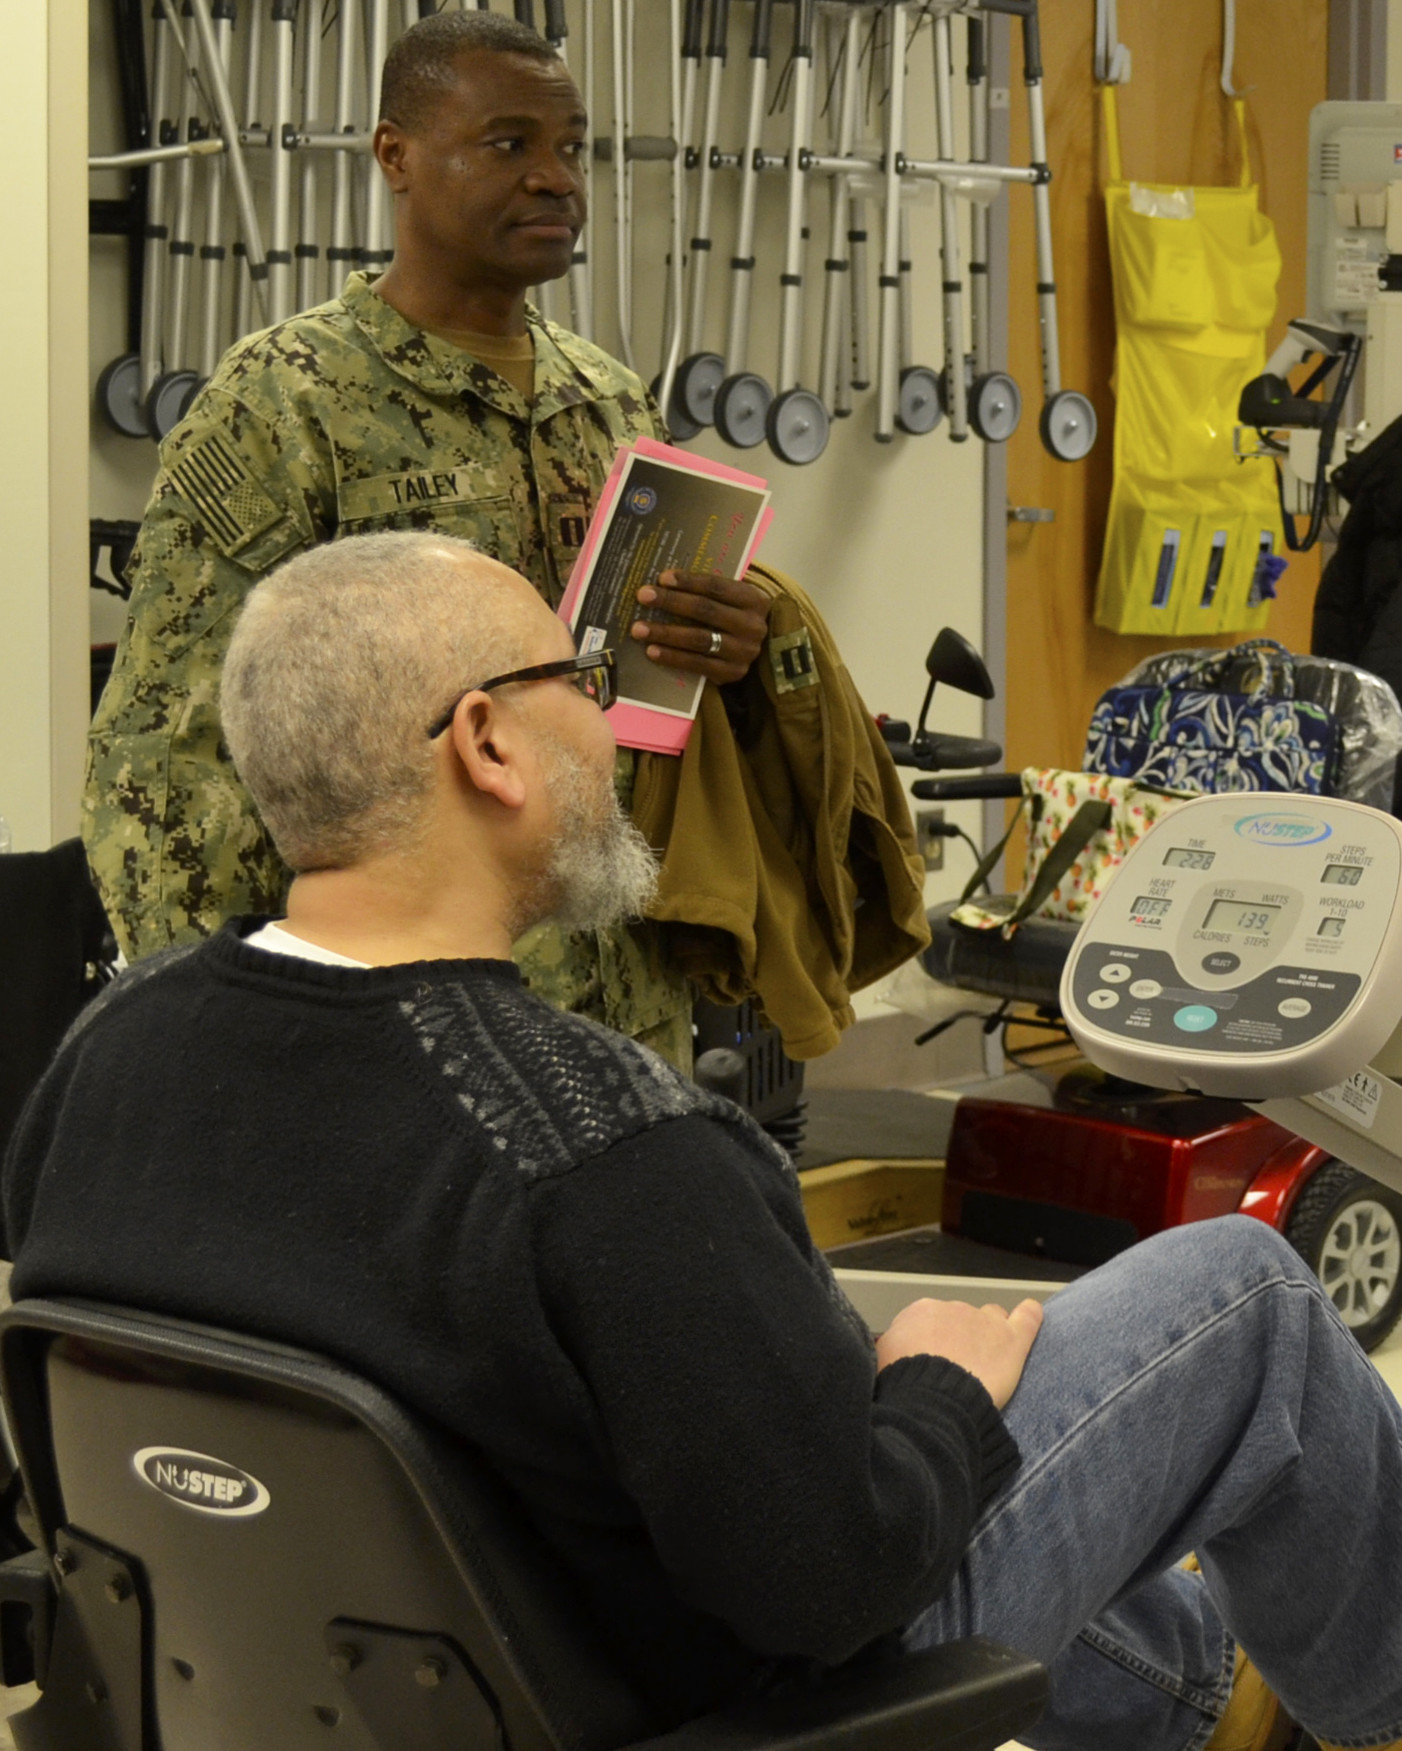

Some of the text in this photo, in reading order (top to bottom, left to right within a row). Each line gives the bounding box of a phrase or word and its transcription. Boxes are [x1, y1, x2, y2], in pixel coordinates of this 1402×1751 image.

[388, 472, 459, 504] TAILEY
[725, 510, 745, 539] You
[1248, 820, 1316, 839] NUSTEP
[1188, 838, 1207, 849] TIME
[1341, 845, 1367, 856] STEPS
[1325, 853, 1374, 867] PER MINUTE
[1149, 878, 1176, 889] HEART
[1338, 868, 1362, 886] 60
[1148, 888, 1169, 898] RATE
[1213, 888, 1289, 905] METS WATTS
[1136, 899, 1172, 917] OFF
[1319, 897, 1365, 910] WORKLOAD
[1329, 907, 1348, 918] 1-10
[1128, 915, 1162, 926] POLAR
[1238, 911, 1270, 930] 139
[1192, 929, 1270, 948] CALORIES STEPS
[1210, 958, 1232, 968] SELECT
[156, 1460, 244, 1503] NUSTEP
